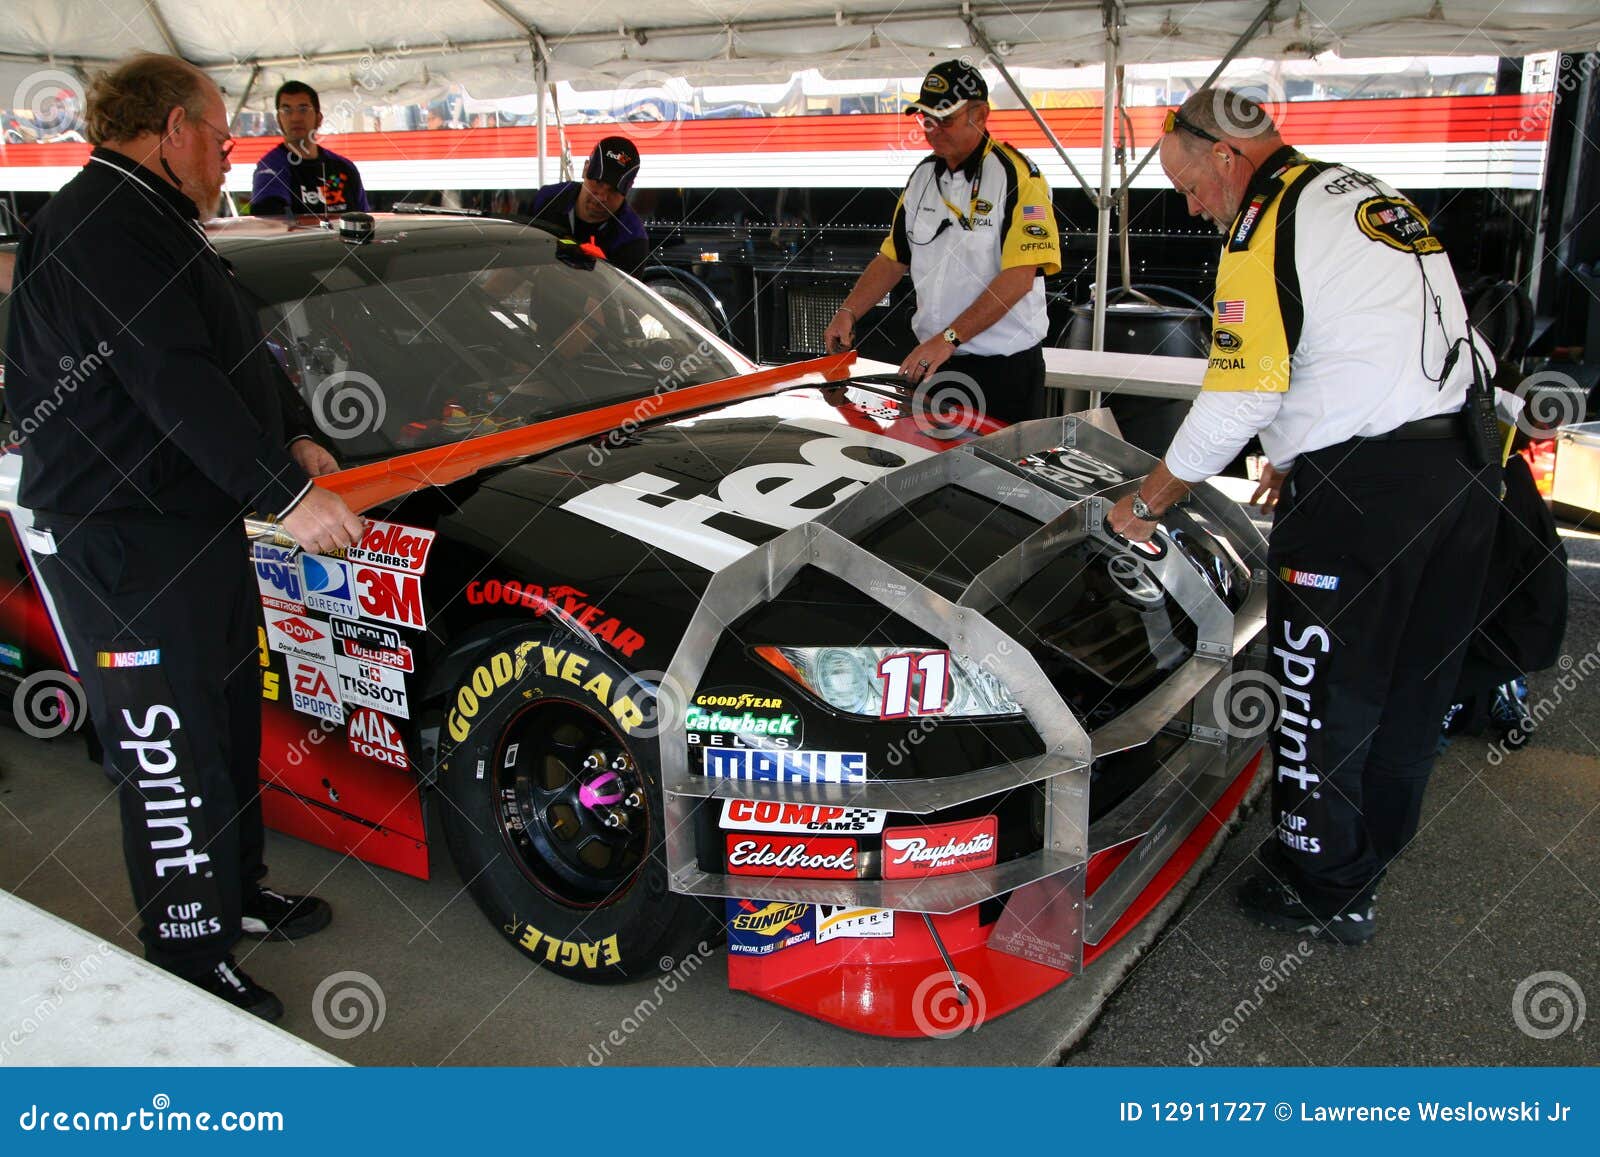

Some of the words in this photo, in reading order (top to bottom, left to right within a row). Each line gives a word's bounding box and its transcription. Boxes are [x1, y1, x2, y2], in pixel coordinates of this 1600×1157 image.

[1235, 206, 1259, 241] NASCAR
[1021, 242, 1056, 252] OFFICIAL
[349, 548, 365, 560] HP
[367, 550, 409, 568] CARBS
[1293, 570, 1338, 590] NASCAR
[308, 596, 353, 615] DIRECTV
[356, 569, 423, 627] 3M
[284, 621, 315, 640] DOW
[113, 649, 160, 667] NASCAR
[278, 642, 293, 652] Dow
[351, 644, 404, 666] WELDERS
[294, 664, 339, 703] EA
[339, 674, 405, 706] TISSOT
[877, 650, 949, 720] 11
[294, 694, 342, 721] SPORTS
[696, 693, 783, 710] GOODYEAR
[1273, 620, 1331, 791] Sprint
[350, 711, 406, 754] MAC
[686, 707, 800, 736] Gatorback
[350, 740, 408, 768] TOOLS
[687, 733, 790, 750] BELTS
[706, 748, 864, 784] MAHLE
[119, 704, 211, 877] Sprint
[728, 799, 845, 826] COMP
[1280, 809, 1308, 832] CUP
[806, 821, 866, 832] CAMS
[1278, 830, 1321, 854] SERIES
[728, 840, 857, 871] Edelbrock
[936, 858, 955, 867] best
[167, 901, 202, 921] CUP
[735, 903, 806, 929] SUNOCO
[159, 916, 222, 939] SERIES
[818, 911, 890, 941] FILTERS
[519, 923, 622, 969] EAGLE
[731, 945, 759, 953] OFFICIAL
[786, 931, 811, 947] NASCAR
